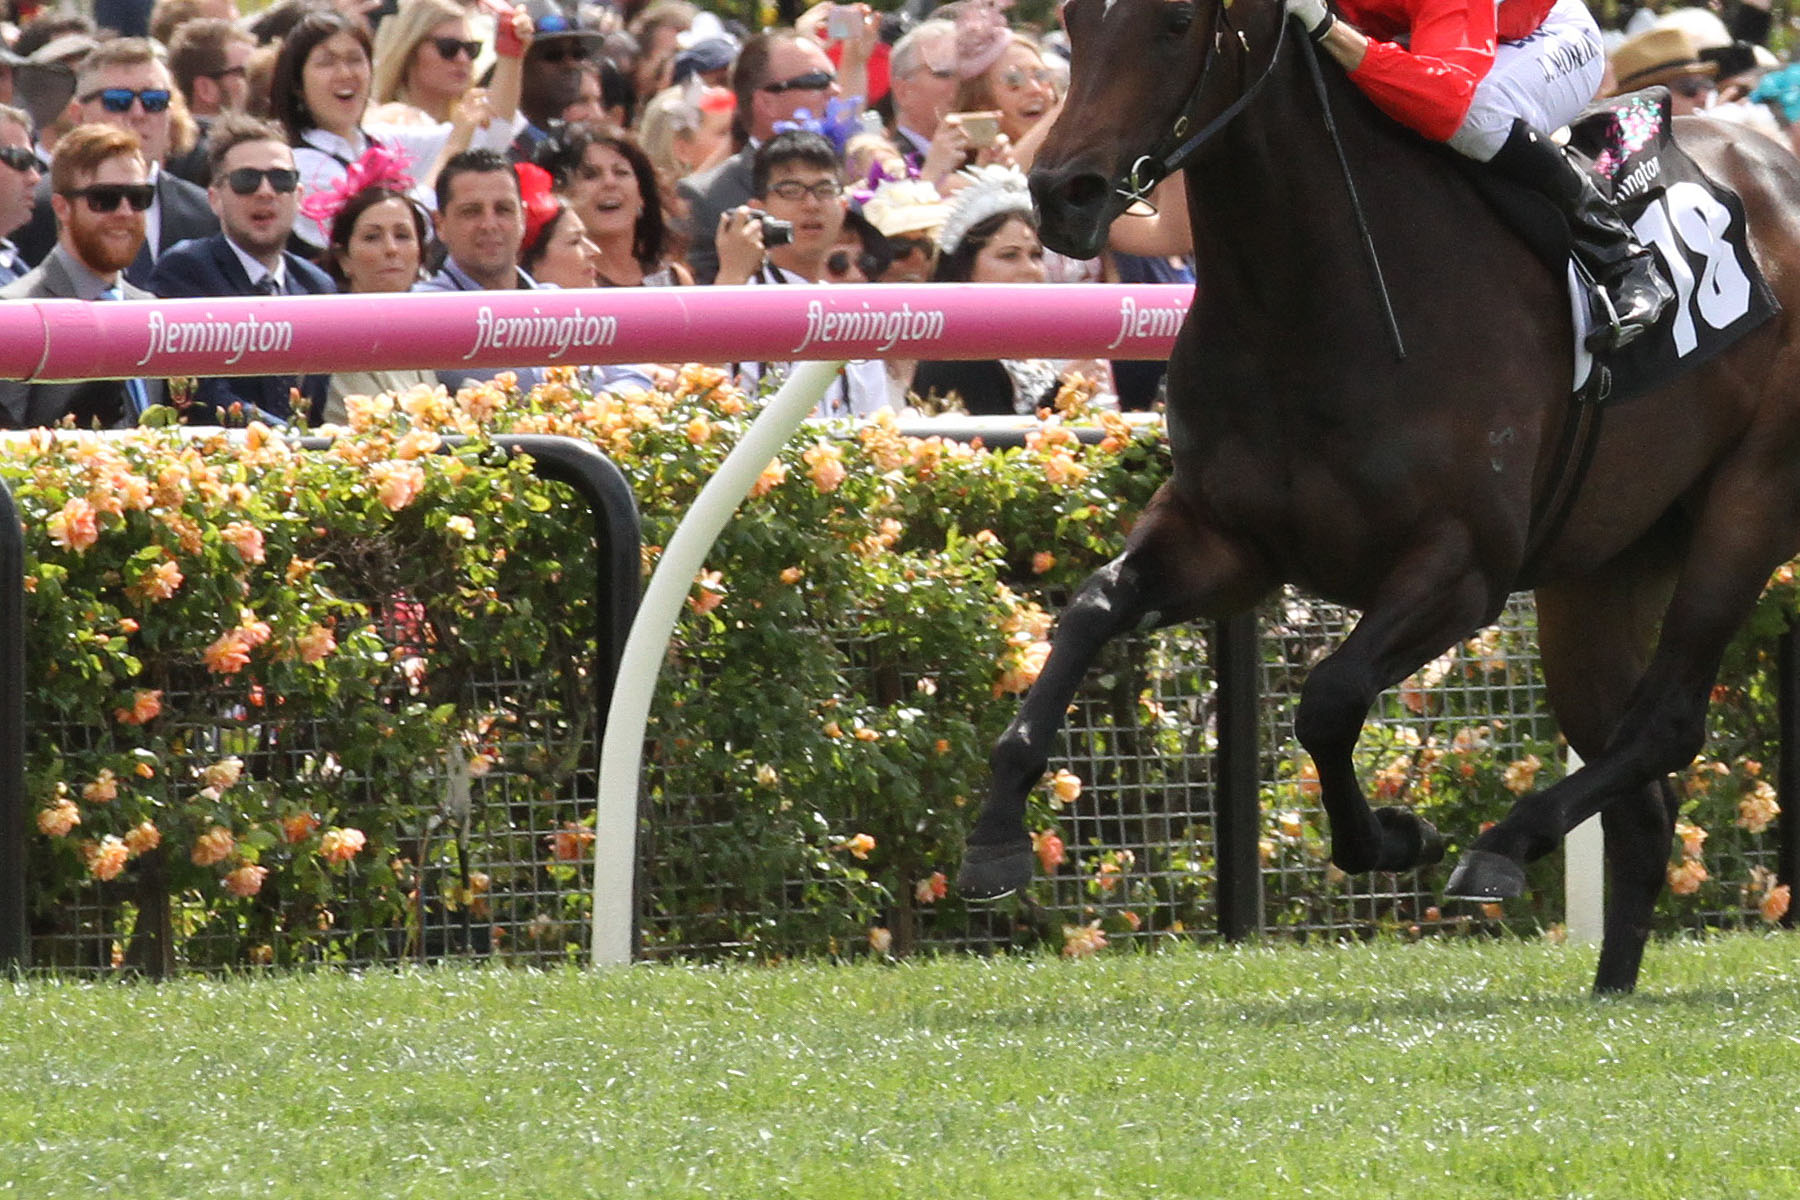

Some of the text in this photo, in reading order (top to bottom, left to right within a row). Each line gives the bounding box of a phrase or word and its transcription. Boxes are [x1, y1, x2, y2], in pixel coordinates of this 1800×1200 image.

[1632, 182, 1750, 358] 18
[138, 310, 293, 366] flemington
[463, 306, 617, 360] flemington
[792, 301, 945, 353] flemington
[1107, 296, 1189, 349] flemi
